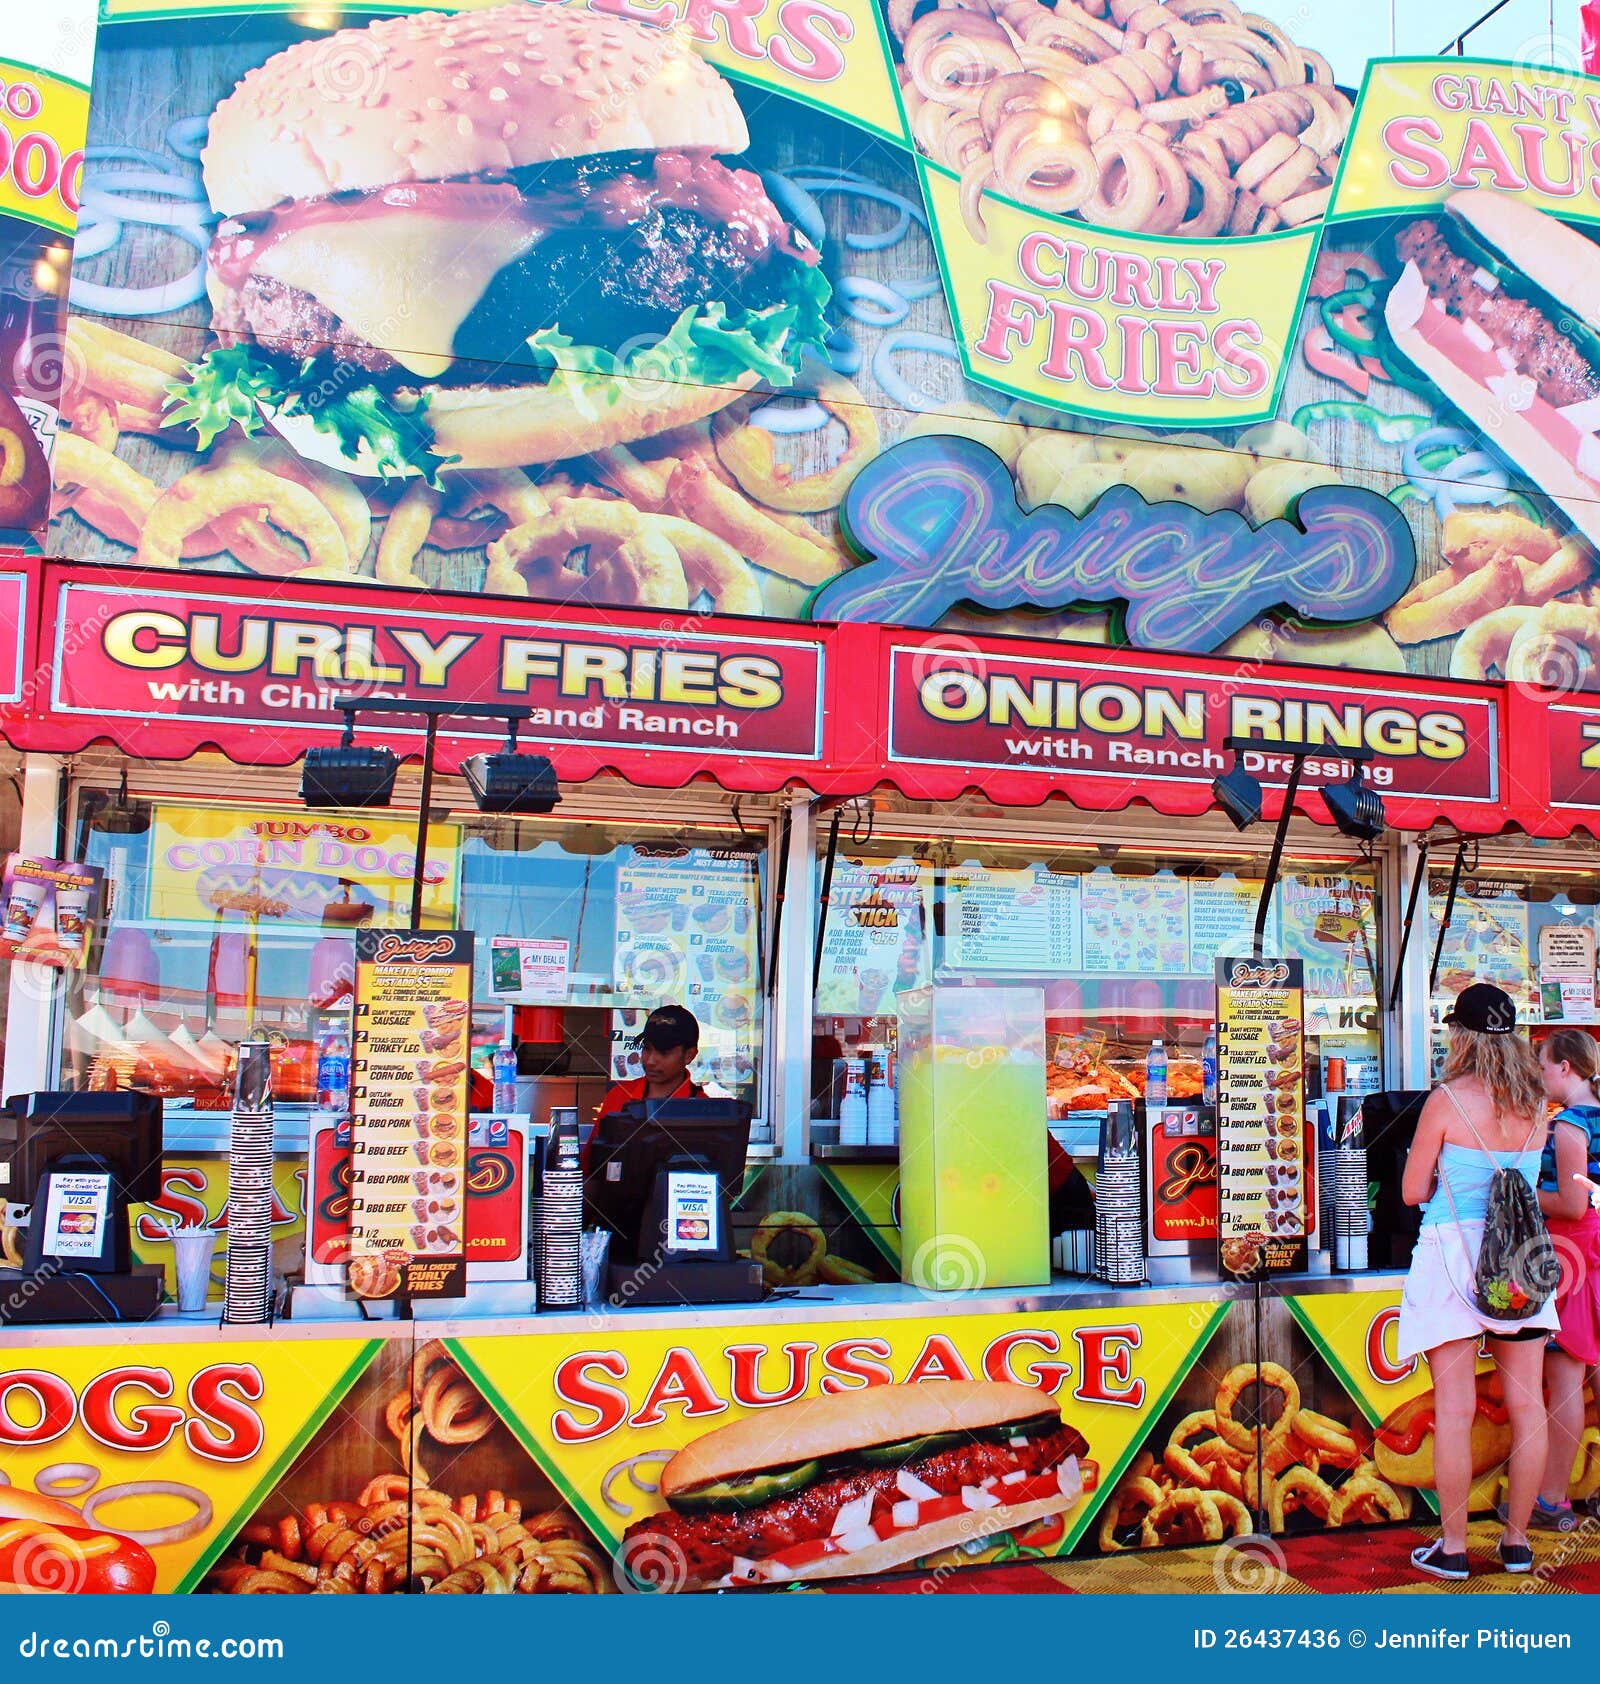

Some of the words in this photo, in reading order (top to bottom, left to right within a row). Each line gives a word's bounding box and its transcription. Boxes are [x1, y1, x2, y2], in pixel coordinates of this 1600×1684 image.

[1432, 74, 1574, 123] GIANT
[1383, 116, 1600, 198] SAU
[1019, 231, 1227, 314] CURLY
[975, 278, 1271, 400] FRIES
[102, 605, 480, 687] CURLY
[501, 635, 786, 709] FRIES
[147, 677, 246, 705] with
[617, 708, 739, 737] Ranch
[917, 667, 1216, 741] ONION
[1228, 696, 1468, 761] RINGS
[1005, 736, 1093, 760] with
[1109, 741, 1226, 769] Ranch
[253, 821, 371, 842] JUMBO
[167, 839, 305, 872] CORN
[318, 840, 449, 886] DOGS
[884, 865, 921, 883] NEW
[829, 887, 885, 906] STEAK
[846, 907, 899, 927] STICK
[373, 967, 398, 976] MAKE
[398, 967, 410, 976] IT
[410, 967, 419, 976] A
[372, 977, 397, 987] JUST
[397, 978, 415, 987] ADD
[416, 975, 431, 989] $5
[1229, 990, 1250, 998] MAKE
[1250, 990, 1257, 998] IT
[1229, 1000, 1248, 1008] JUST
[1248, 1000, 1261, 1008] ADD
[1261, 998, 1273, 1009] $5
[371, 1017, 410, 1025] SAUSAGE
[369, 1044, 402, 1053] TURKEY
[403, 1045, 420, 1053] LEG
[370, 1072, 393, 1080] CORN
[395, 1072, 414, 1080] DOG
[1230, 1080, 1249, 1088] CORN
[369, 1099, 404, 1107] BURGER
[1230, 1103, 1257, 1111] BURGER
[368, 1120, 387, 1128] BBQ
[389, 1119, 412, 1127] PORK
[1231, 1120, 1244, 1128] BBQ
[1245, 1120, 1263, 1128] PORK
[368, 1147, 385, 1156] BBQ
[386, 1147, 408, 1155] BEEF
[1231, 1144, 1246, 1152] BBQ
[1231, 1168, 1245, 1176] BBQ
[1246, 1168, 1264, 1176] PORK
[367, 1176, 384, 1184] BBQ
[386, 1175, 410, 1184] PORK
[366, 1204, 384, 1213] BBQ
[386, 1203, 407, 1212] BEEF
[1232, 1223, 1261, 1231] CHICKEN
[366, 1229, 379, 1238] 1/2
[365, 1239, 404, 1248] CHICKEN
[1265, 1250, 1295, 1259] CURLY
[1265, 1259, 1292, 1267] FRIES
[408, 1271, 449, 1280] CURLY
[408, 1281, 444, 1291] FRIES
[551, 1323, 1147, 1444] SAUSAGE
